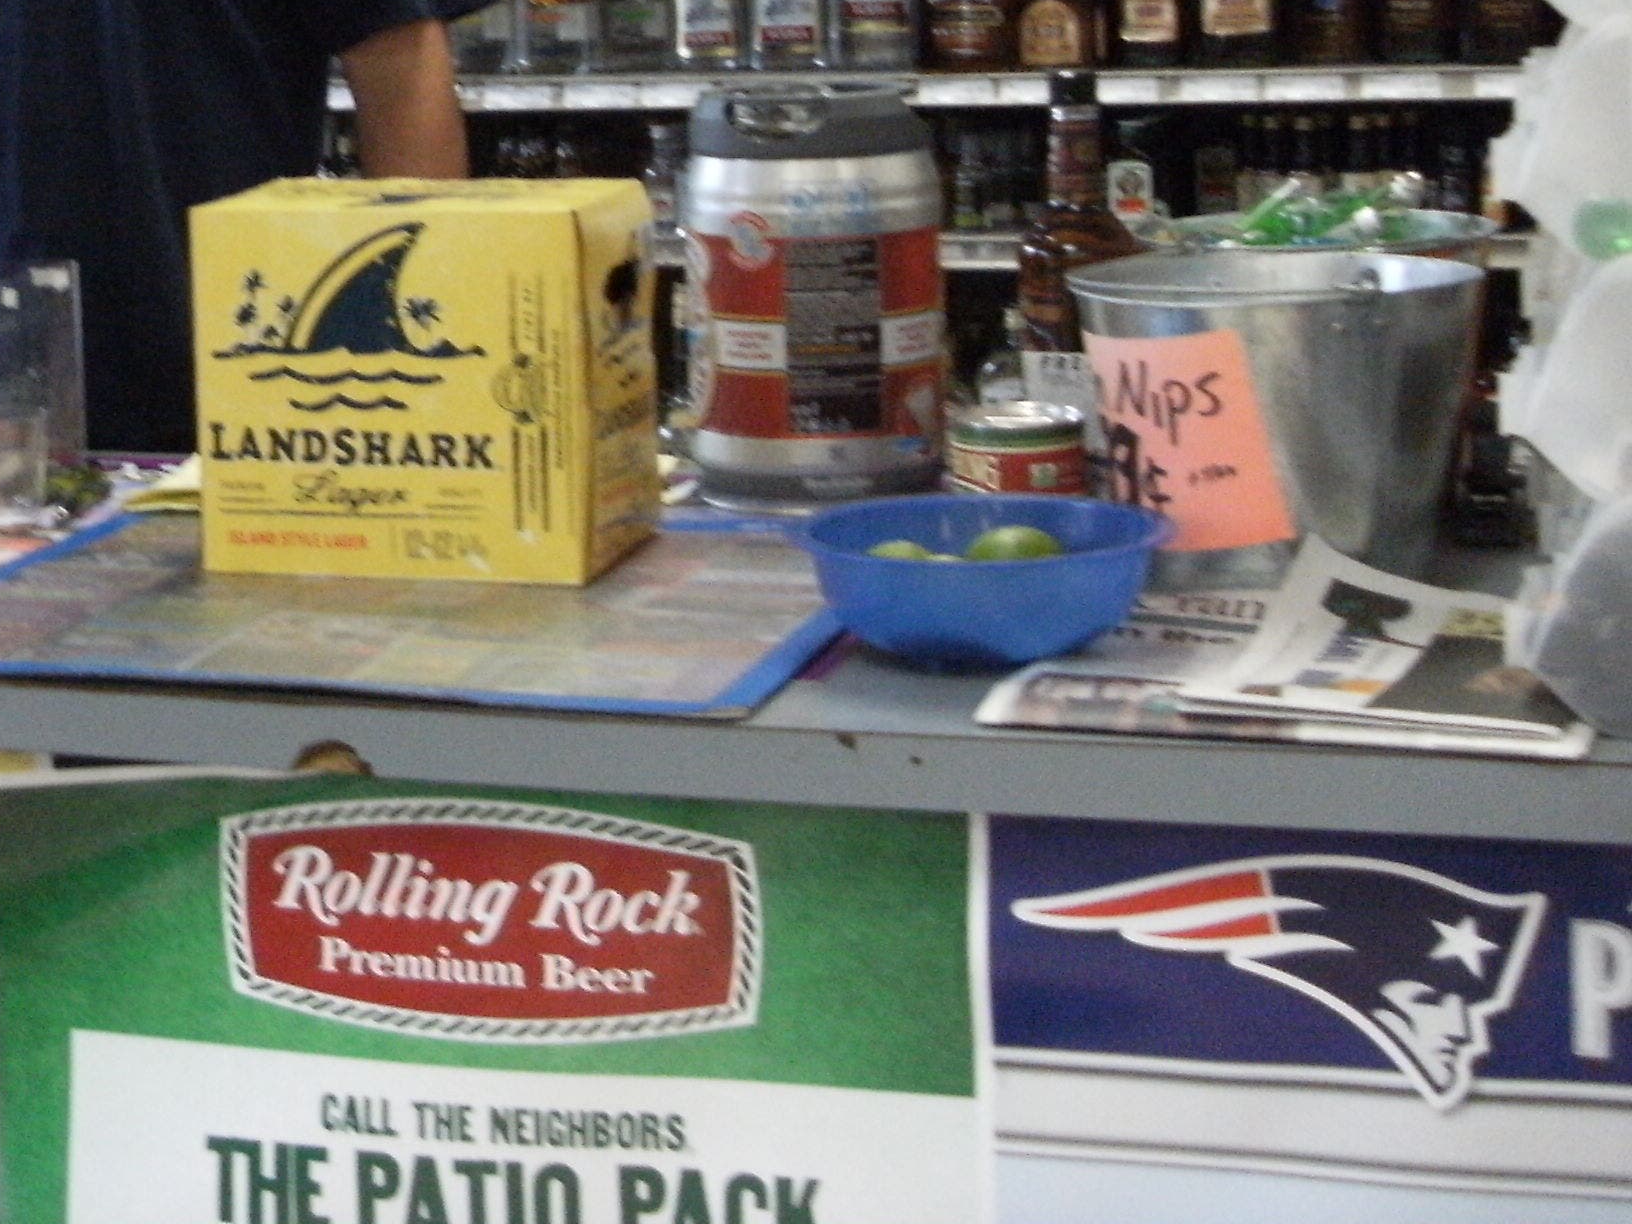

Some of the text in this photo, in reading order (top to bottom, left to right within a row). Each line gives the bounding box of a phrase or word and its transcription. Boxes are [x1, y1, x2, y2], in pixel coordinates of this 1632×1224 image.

[1116, 360, 1222, 447] Nips
[209, 422, 495, 469] LANDSHARK
[292, 469, 407, 516] Lager
[272, 844, 703, 948] Rolling Rock
[319, 935, 656, 996] Premium Beer
[320, 1093, 685, 1151] CALL THE NEIGHBORS
[207, 1135, 823, 1224] THE PATIO PACK
